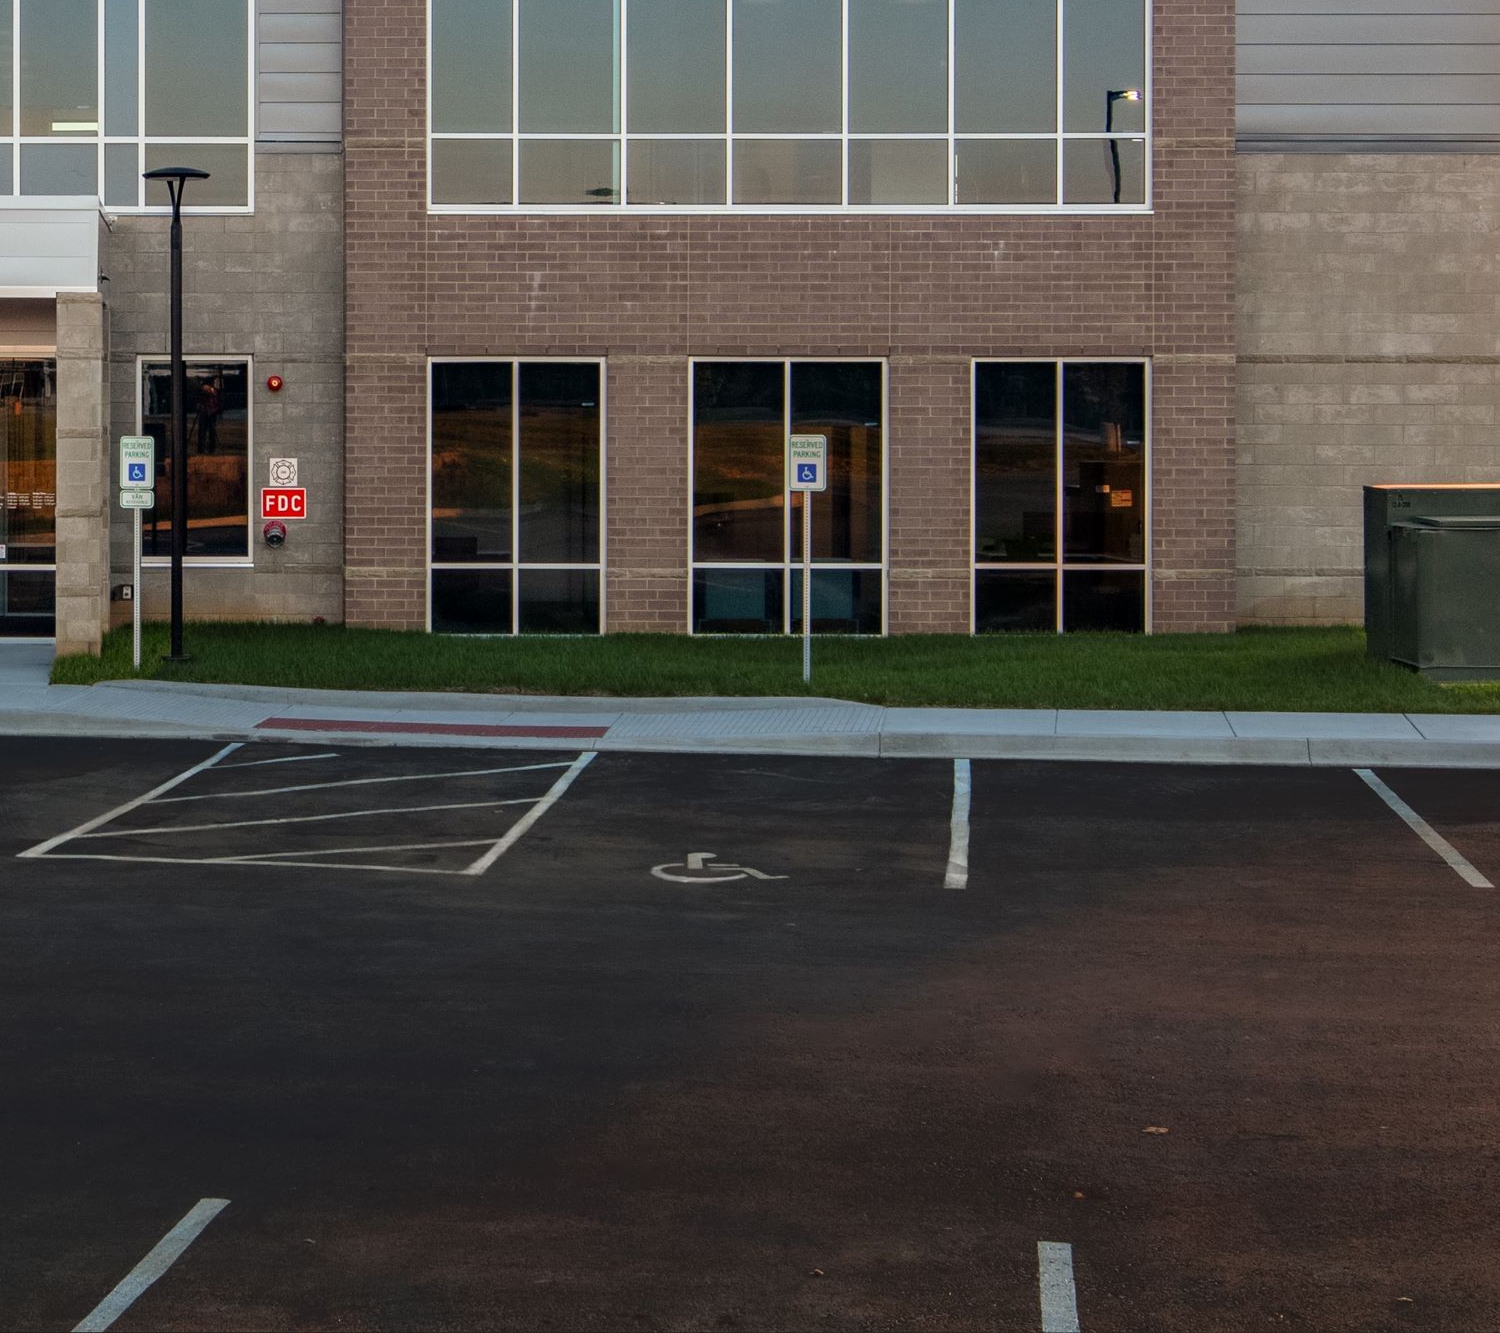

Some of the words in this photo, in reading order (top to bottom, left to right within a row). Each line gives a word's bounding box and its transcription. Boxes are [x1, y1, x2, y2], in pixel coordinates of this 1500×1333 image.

[123, 442, 151, 450] RESERVED
[791, 441, 823, 449] RESERVED
[793, 450, 821, 458] PARKING
[265, 495, 301, 511] FDC
